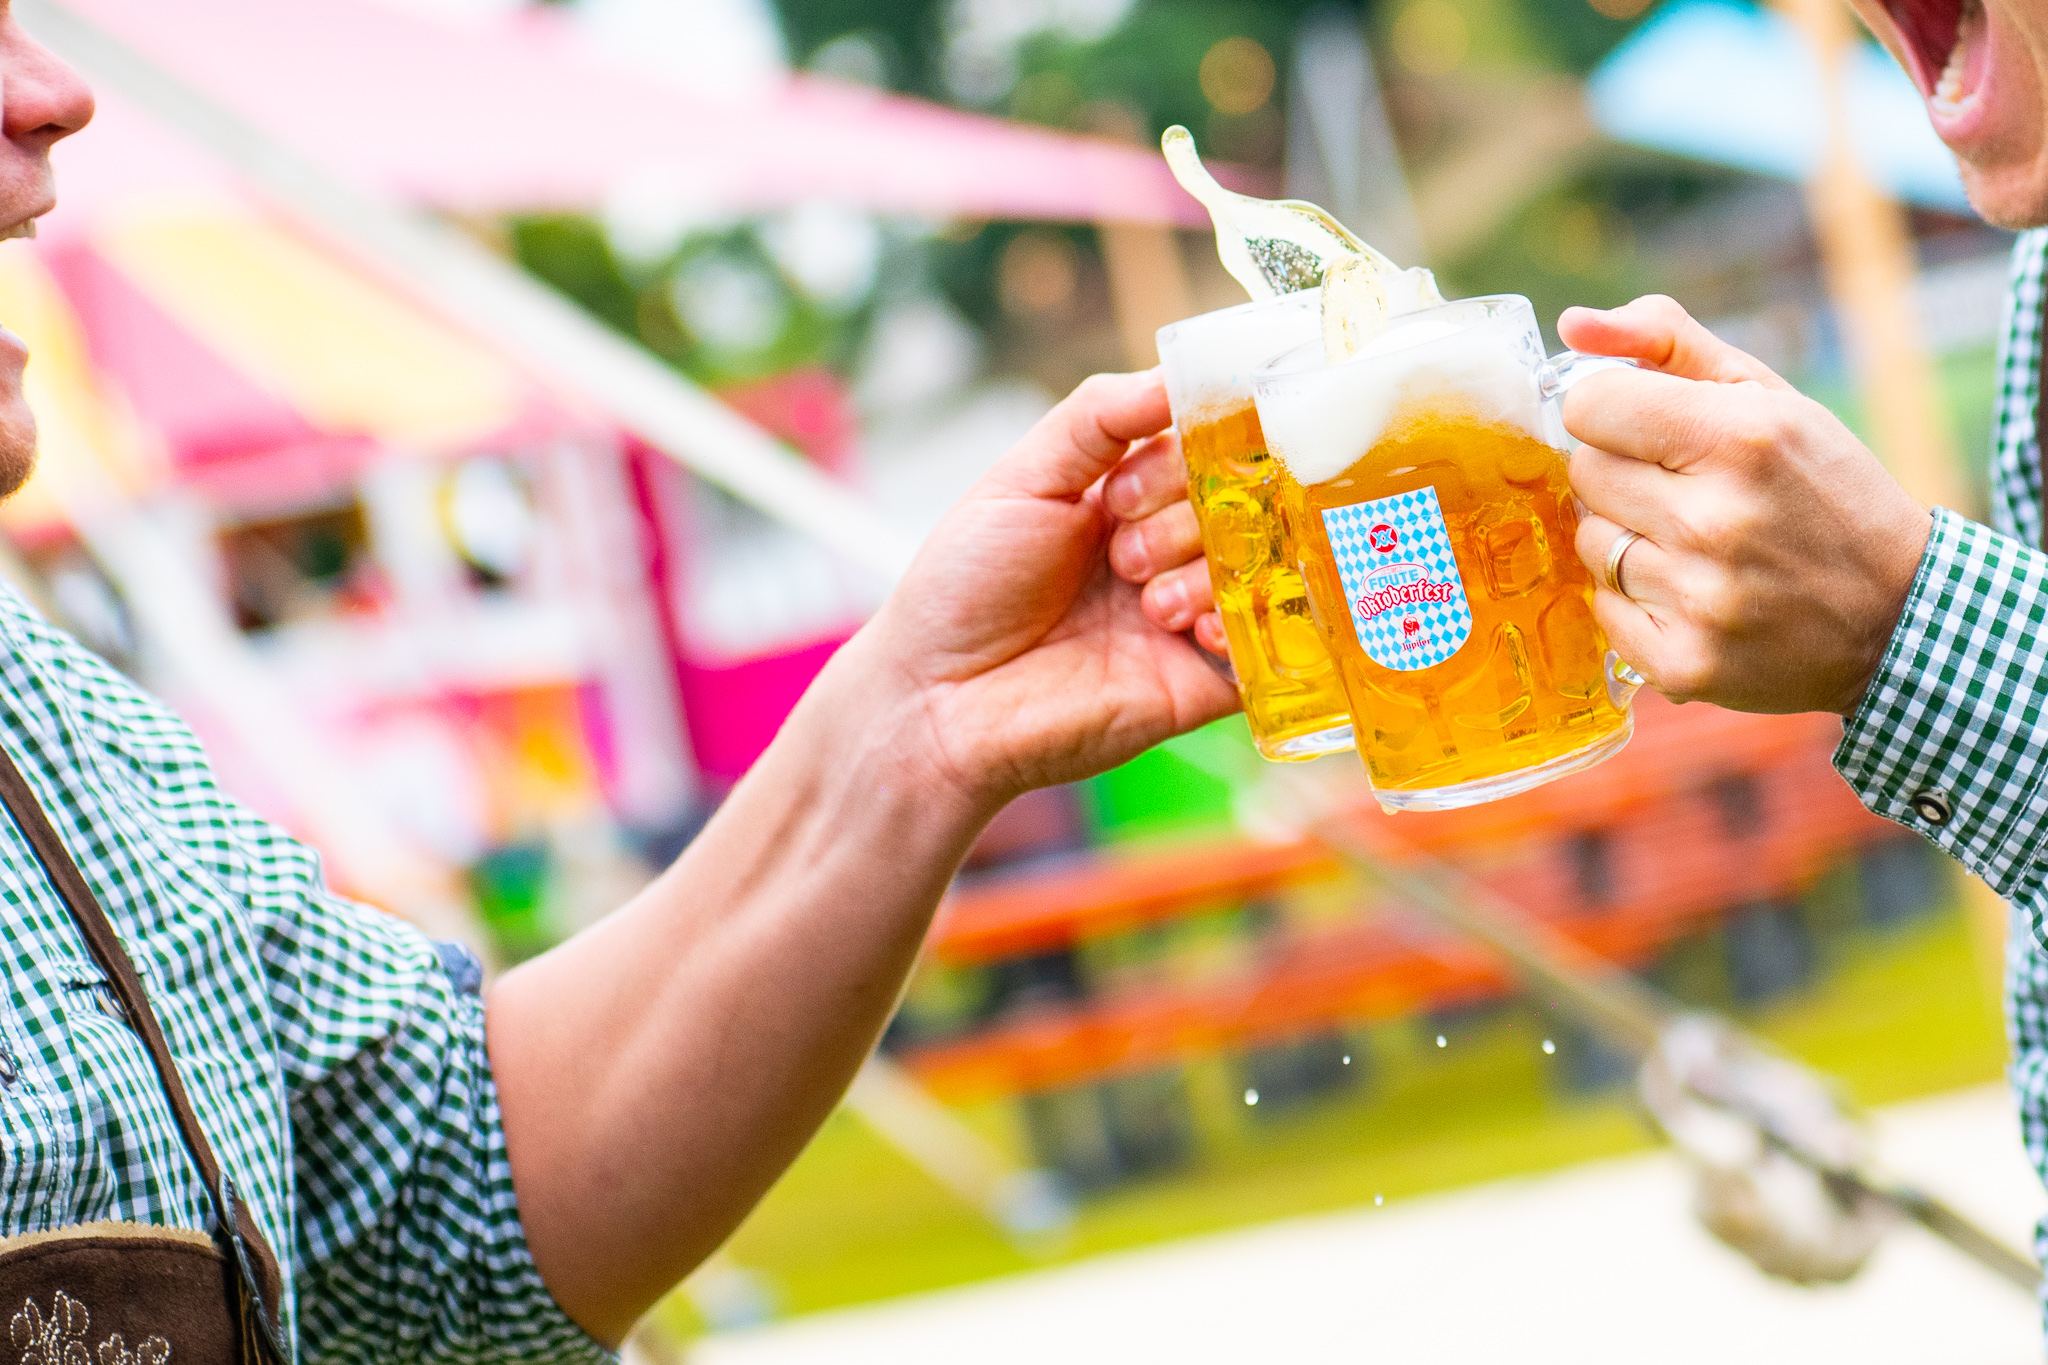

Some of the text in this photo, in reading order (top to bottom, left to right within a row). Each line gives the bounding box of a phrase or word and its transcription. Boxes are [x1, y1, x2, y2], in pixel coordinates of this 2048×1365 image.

[1368, 569, 1419, 590] FOUTE
[1357, 578, 1453, 620] Oktoberfest
[1402, 639, 1432, 652] Jupiler
